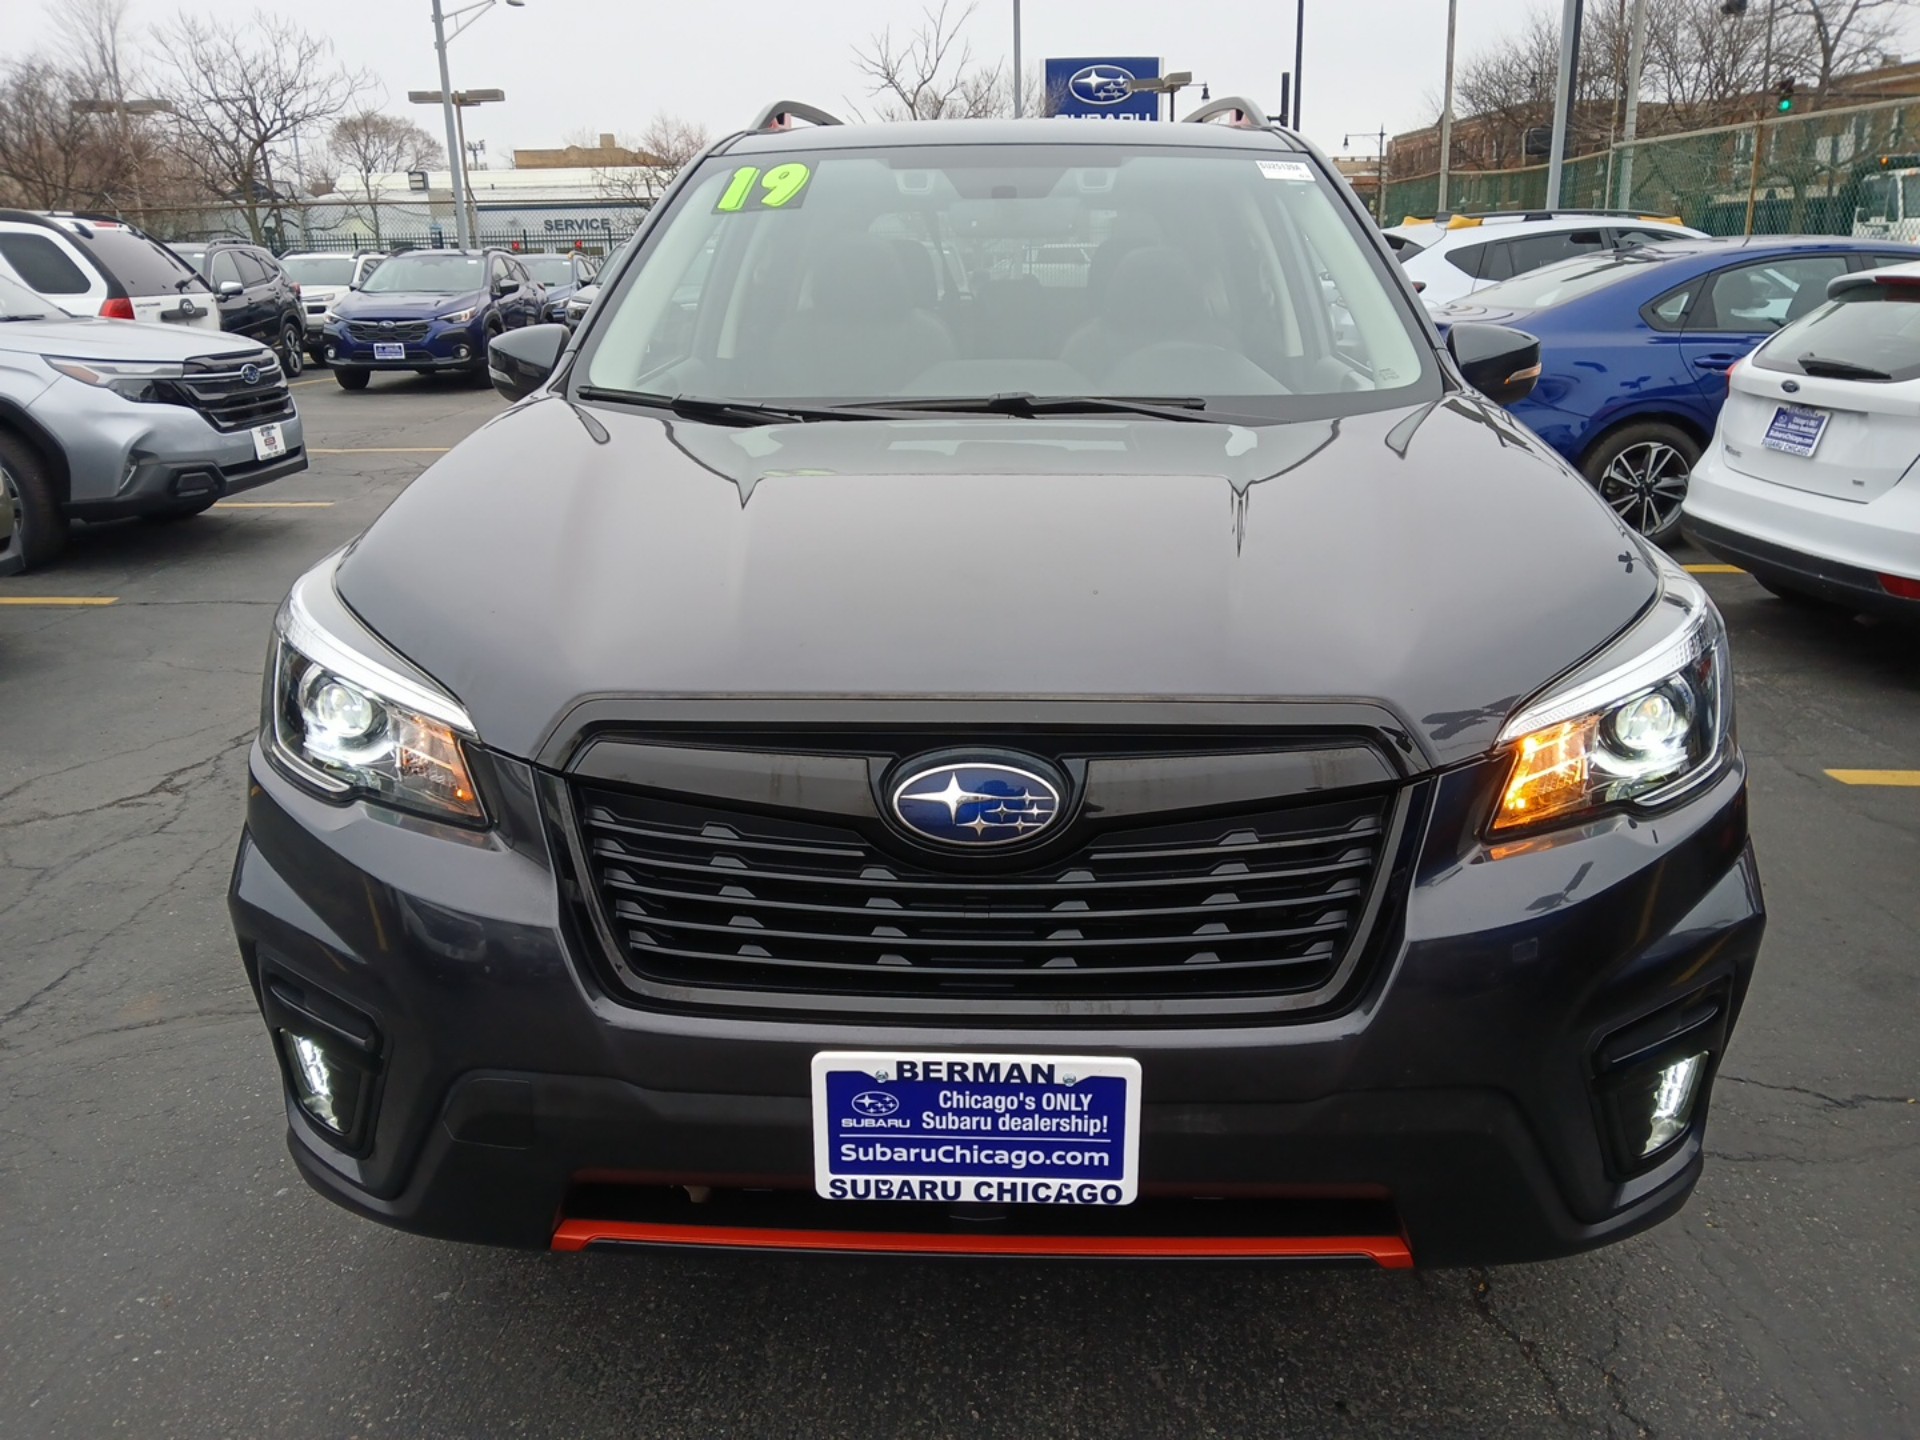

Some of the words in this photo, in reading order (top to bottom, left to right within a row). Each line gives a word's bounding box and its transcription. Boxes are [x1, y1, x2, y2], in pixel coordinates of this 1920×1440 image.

[717, 163, 810, 211] 19
[543, 218, 611, 231] SERVICE
[895, 1060, 1056, 1085] BERMAN
[938, 1089, 1036, 1113] Chicago's
[1042, 1092, 1093, 1112] ONLY
[841, 1118, 911, 1129] SUBARU
[921, 1111, 992, 1131] Subaru
[998, 1113, 1108, 1137] dealership!
[840, 1143, 1110, 1169] SubaruChicago.com
[828, 1178, 962, 1201] SUBARU
[973, 1180, 1124, 1205] CHICAGO
